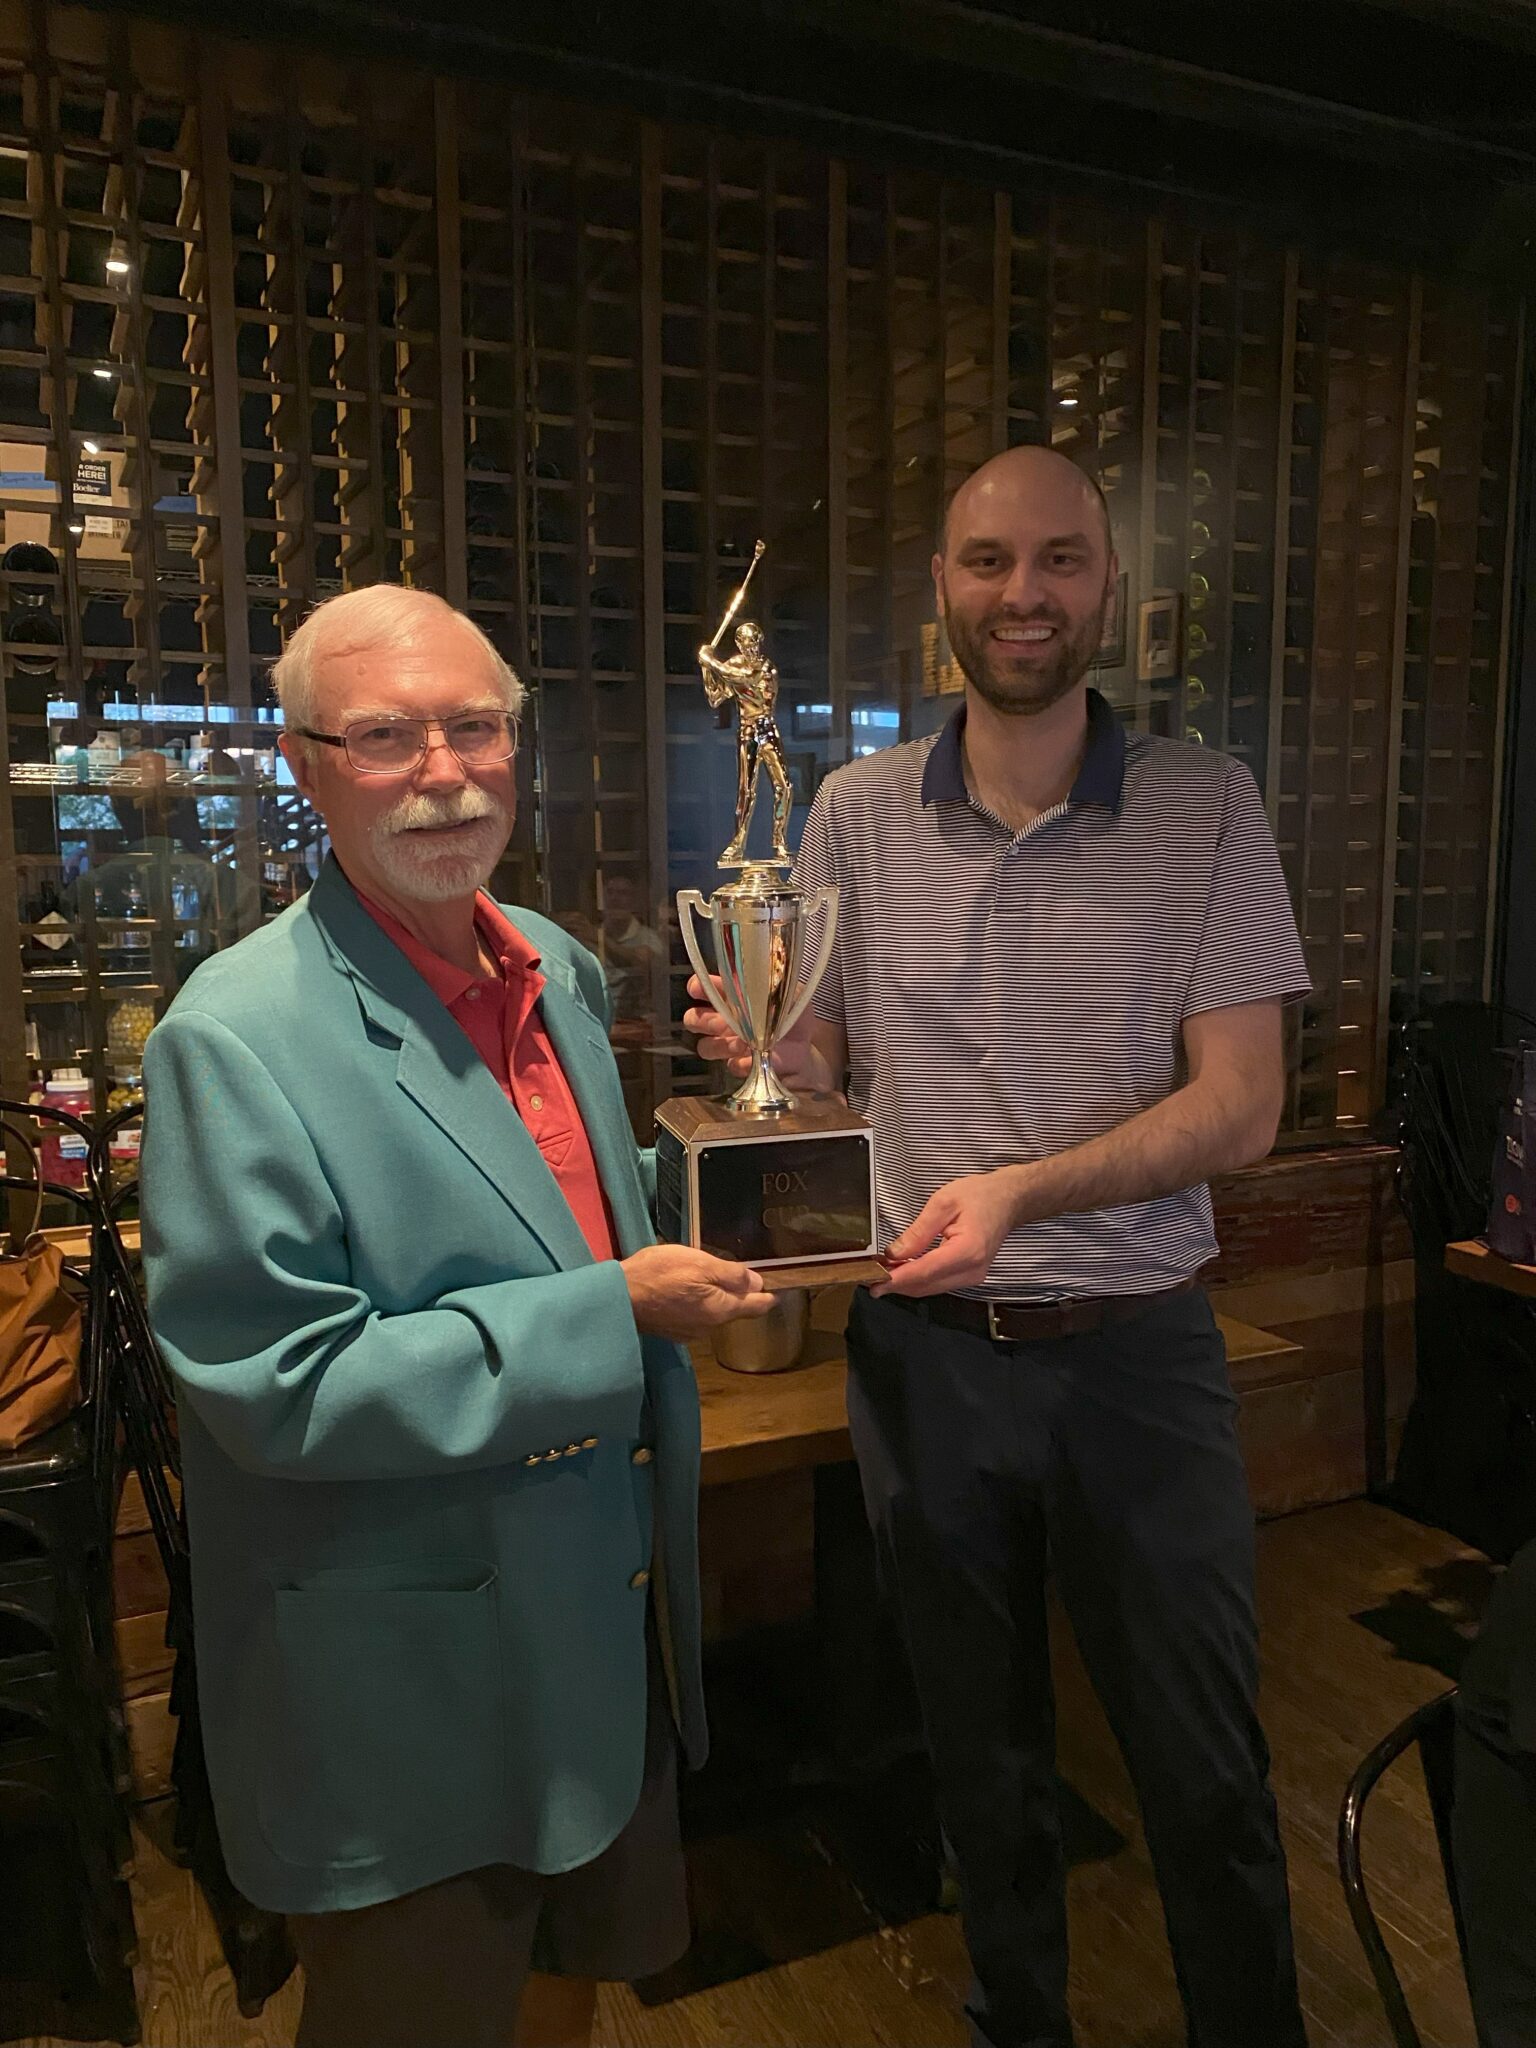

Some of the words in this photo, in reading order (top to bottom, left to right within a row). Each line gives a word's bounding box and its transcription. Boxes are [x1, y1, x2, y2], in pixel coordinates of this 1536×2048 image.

[77, 470, 106, 480] HERE!
[84, 464, 106, 472] ORDER
[762, 1170, 808, 1194] FOX
[762, 1205, 809, 1228] CUP
